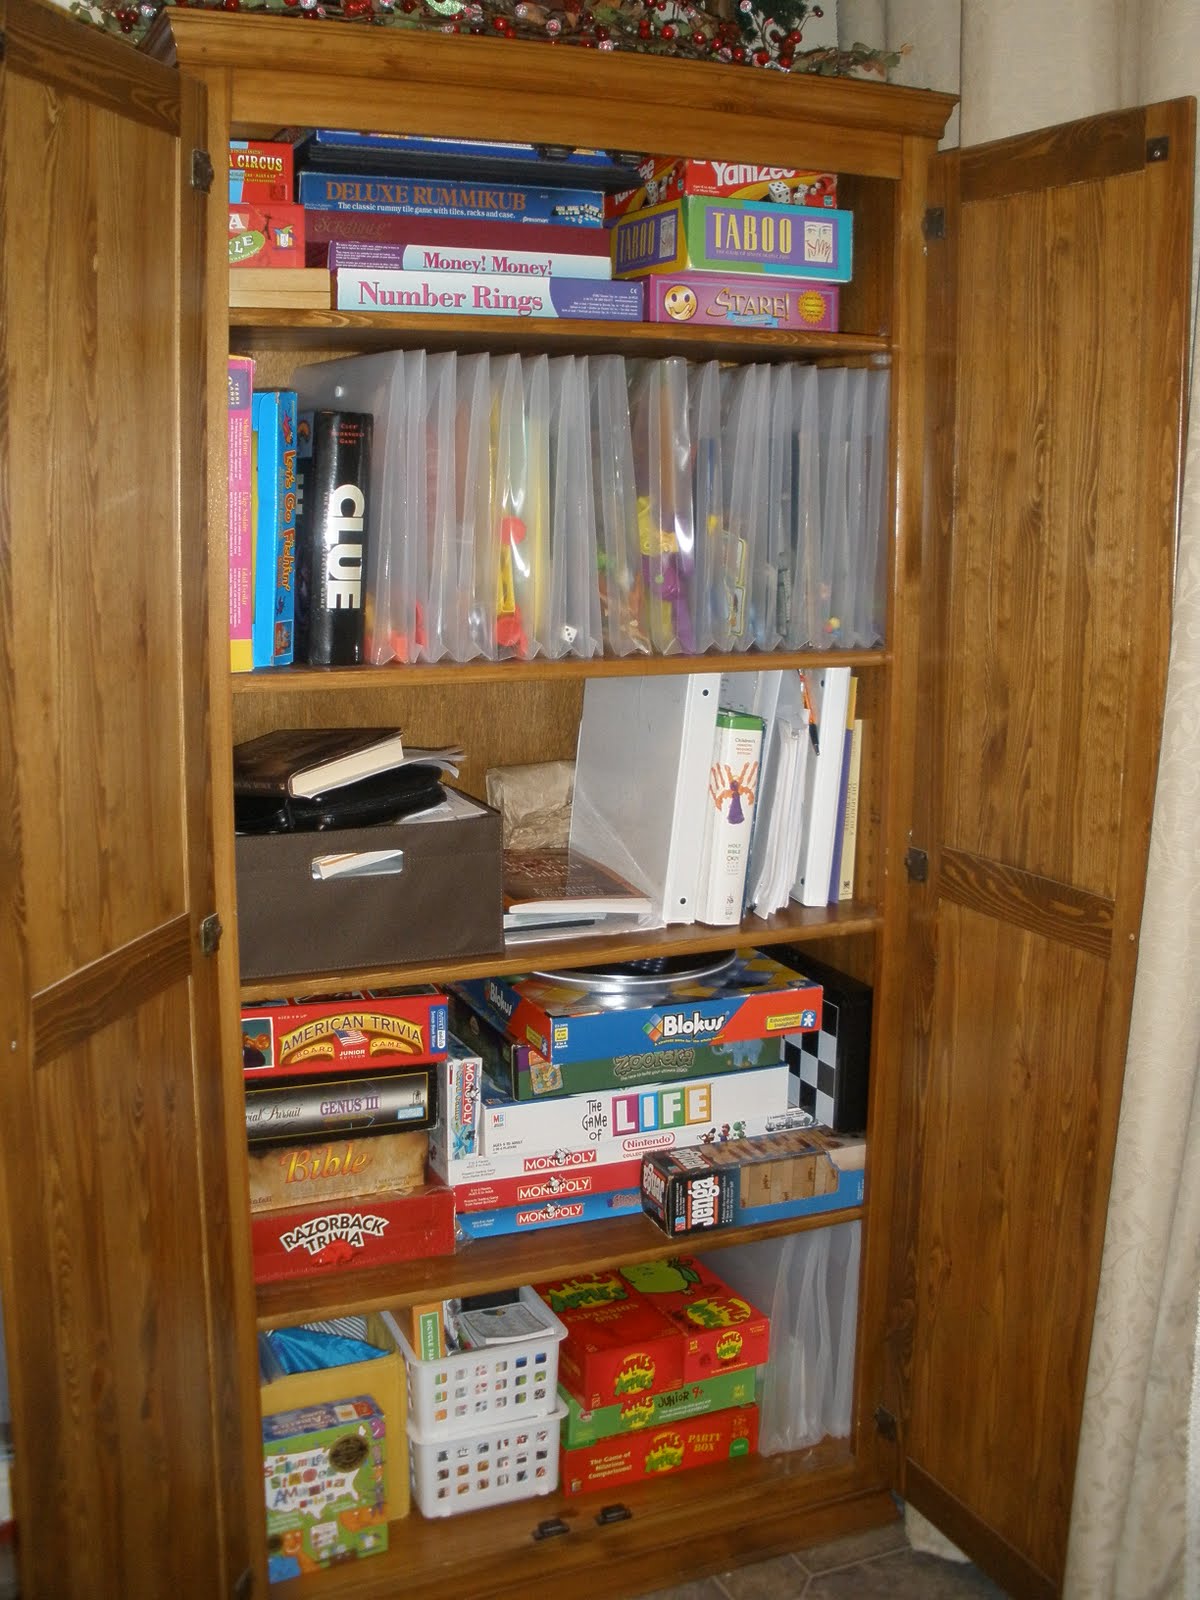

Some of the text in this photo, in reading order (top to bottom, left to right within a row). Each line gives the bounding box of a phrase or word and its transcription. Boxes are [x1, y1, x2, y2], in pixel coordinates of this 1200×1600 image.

[237, 154, 283, 171] CIRCUS
[326, 181, 527, 211] DELUXE RUMMIKUB
[338, 202, 351, 210] The
[352, 203, 376, 211] classic
[377, 205, 401, 213] rummy
[403, 205, 413, 213] tile
[414, 207, 433, 215] game
[434, 207, 449, 215] with
[466, 209, 486, 217] racks
[618, 220, 656, 264] TABOO
[713, 211, 793, 255] TABOO
[422, 251, 487, 273] Money!
[491, 255, 553, 277] Money!
[358, 280, 467, 309] Number
[472, 285, 544, 317] Rings
[706, 288, 791, 321] STARE!
[283, 450, 297, 489] Let's
[283, 493, 296, 523] Go
[327, 484, 366, 609] CLUE
[282, 1015, 364, 1055] AMERICAN
[370, 1016, 422, 1044] TRIVIA
[662, 1010, 727, 1038] Blokus
[297, 1040, 402, 1058] BOARD GAME
[339, 1049, 365, 1057] JUNIOR
[320, 1096, 380, 1116] GENUS III
[463, 1063, 475, 1124] MONOPOLY
[267, 1105, 301, 1121] Pursuit
[615, 1084, 710, 1133] LIFE
[627, 1136, 670, 1149] Nintendo
[280, 1143, 372, 1184] Bible
[525, 1151, 596, 1171] MONOPOLY
[520, 1178, 590, 1199] MONOPOLY
[643, 1164, 665, 1204] Jenga
[519, 1205, 582, 1224] MONOPOLY
[687, 1176, 720, 1227] Jenga
[281, 1214, 389, 1251] RAZORBACK
[304, 1230, 364, 1255] TRIVIA
[688, 1433, 721, 1443] PARTY
[694, 1442, 714, 1452] BOX
[590, 1457, 603, 1466] The
[604, 1455, 622, 1463] Game
